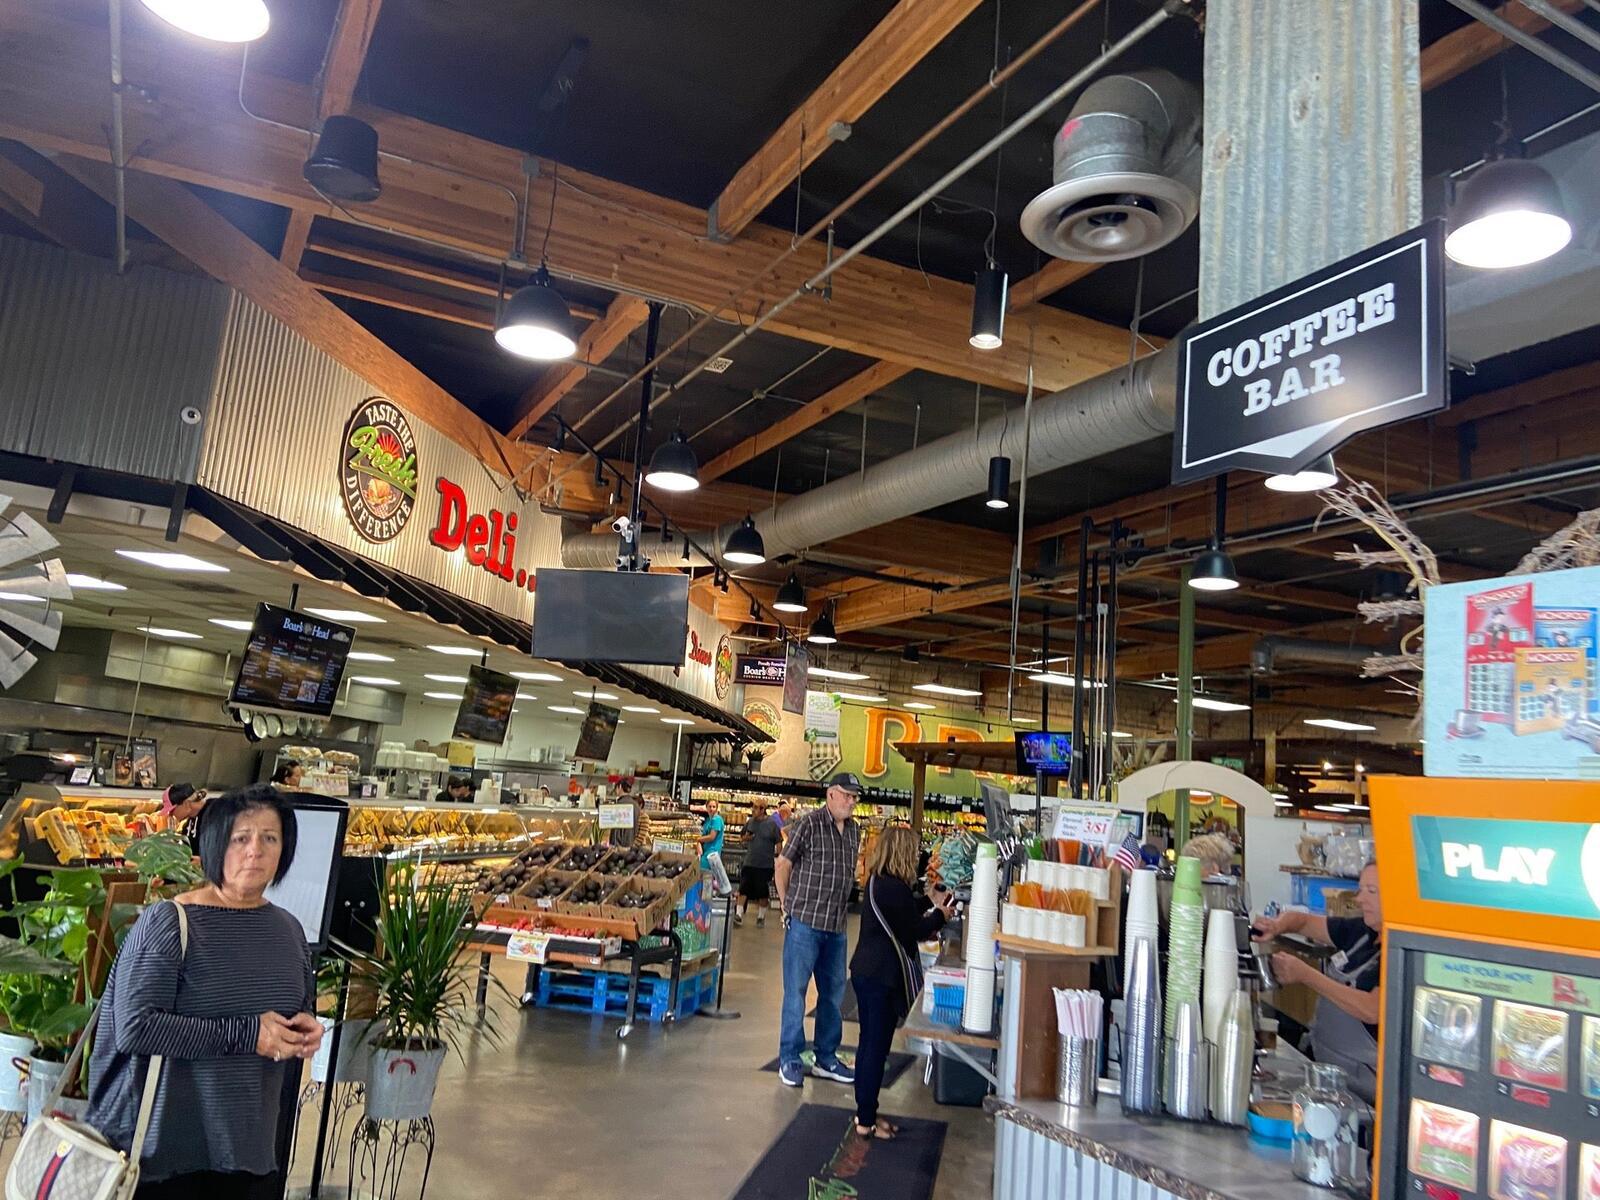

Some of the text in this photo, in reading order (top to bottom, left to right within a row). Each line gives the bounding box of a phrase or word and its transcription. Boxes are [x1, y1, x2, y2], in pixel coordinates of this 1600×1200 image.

[1207, 282, 1396, 387] COFFEE
[1243, 353, 1346, 417] BAR
[349, 425, 418, 489] Fresh
[366, 403, 415, 453] TASTE THE
[345, 474, 412, 539] DIFFERENCE
[311, 624, 331, 640] Head
[1441, 842, 1556, 886] PLAY
